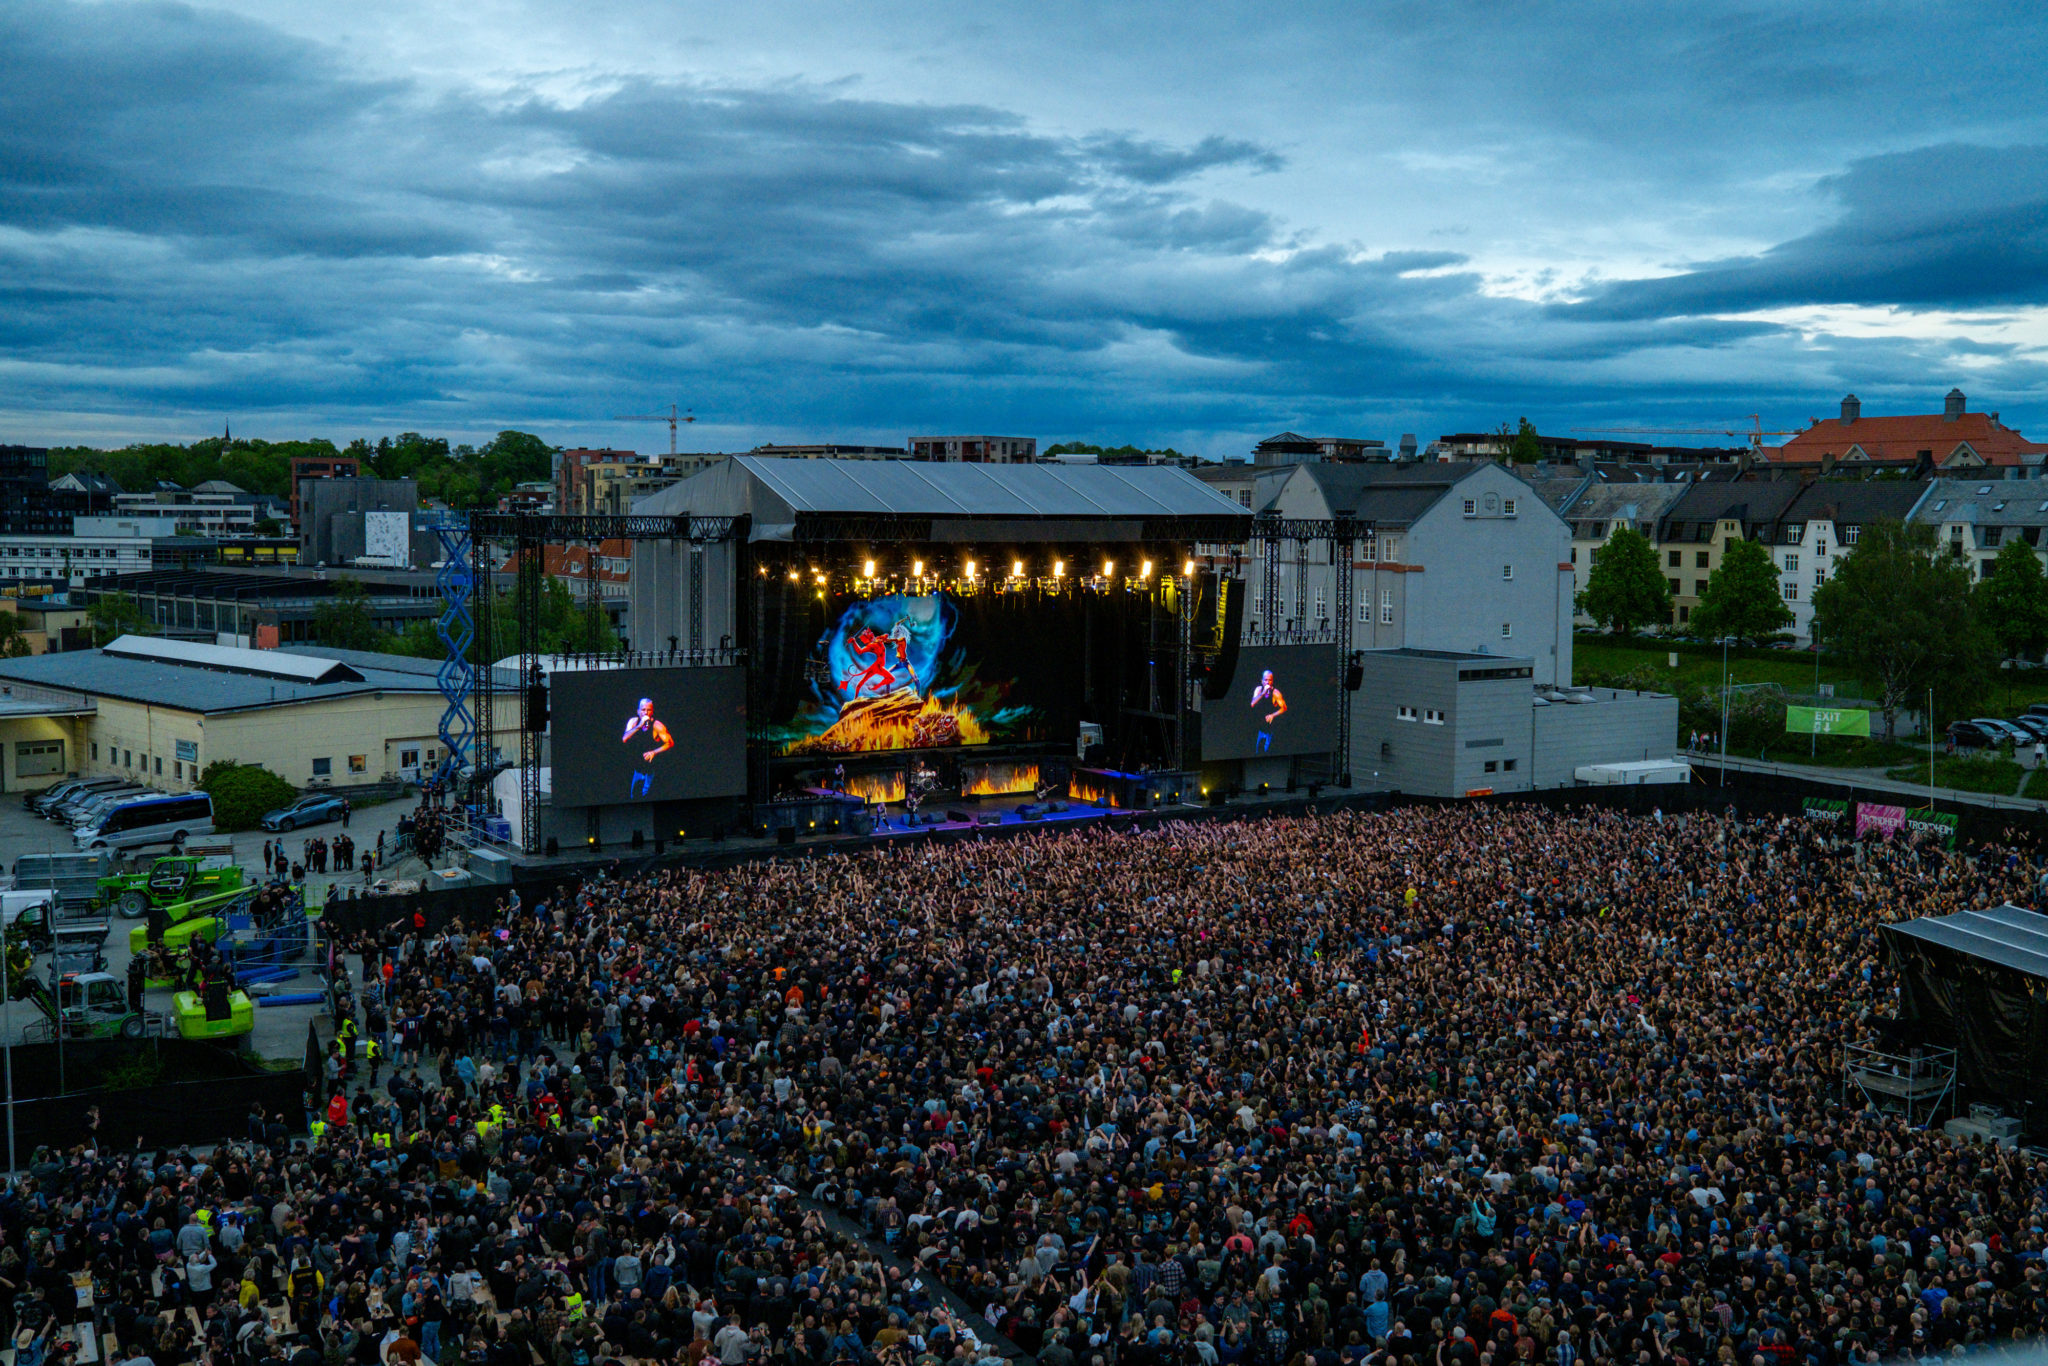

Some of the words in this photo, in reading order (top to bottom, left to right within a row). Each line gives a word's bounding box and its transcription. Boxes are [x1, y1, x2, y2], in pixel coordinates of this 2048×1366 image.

[1815, 711, 1841, 722] EXIT
[1805, 808, 1840, 821] TRONDHEI
[1861, 814, 1902, 828] TRONDHEIM
[1908, 820, 1954, 836] TRONDHEIM
